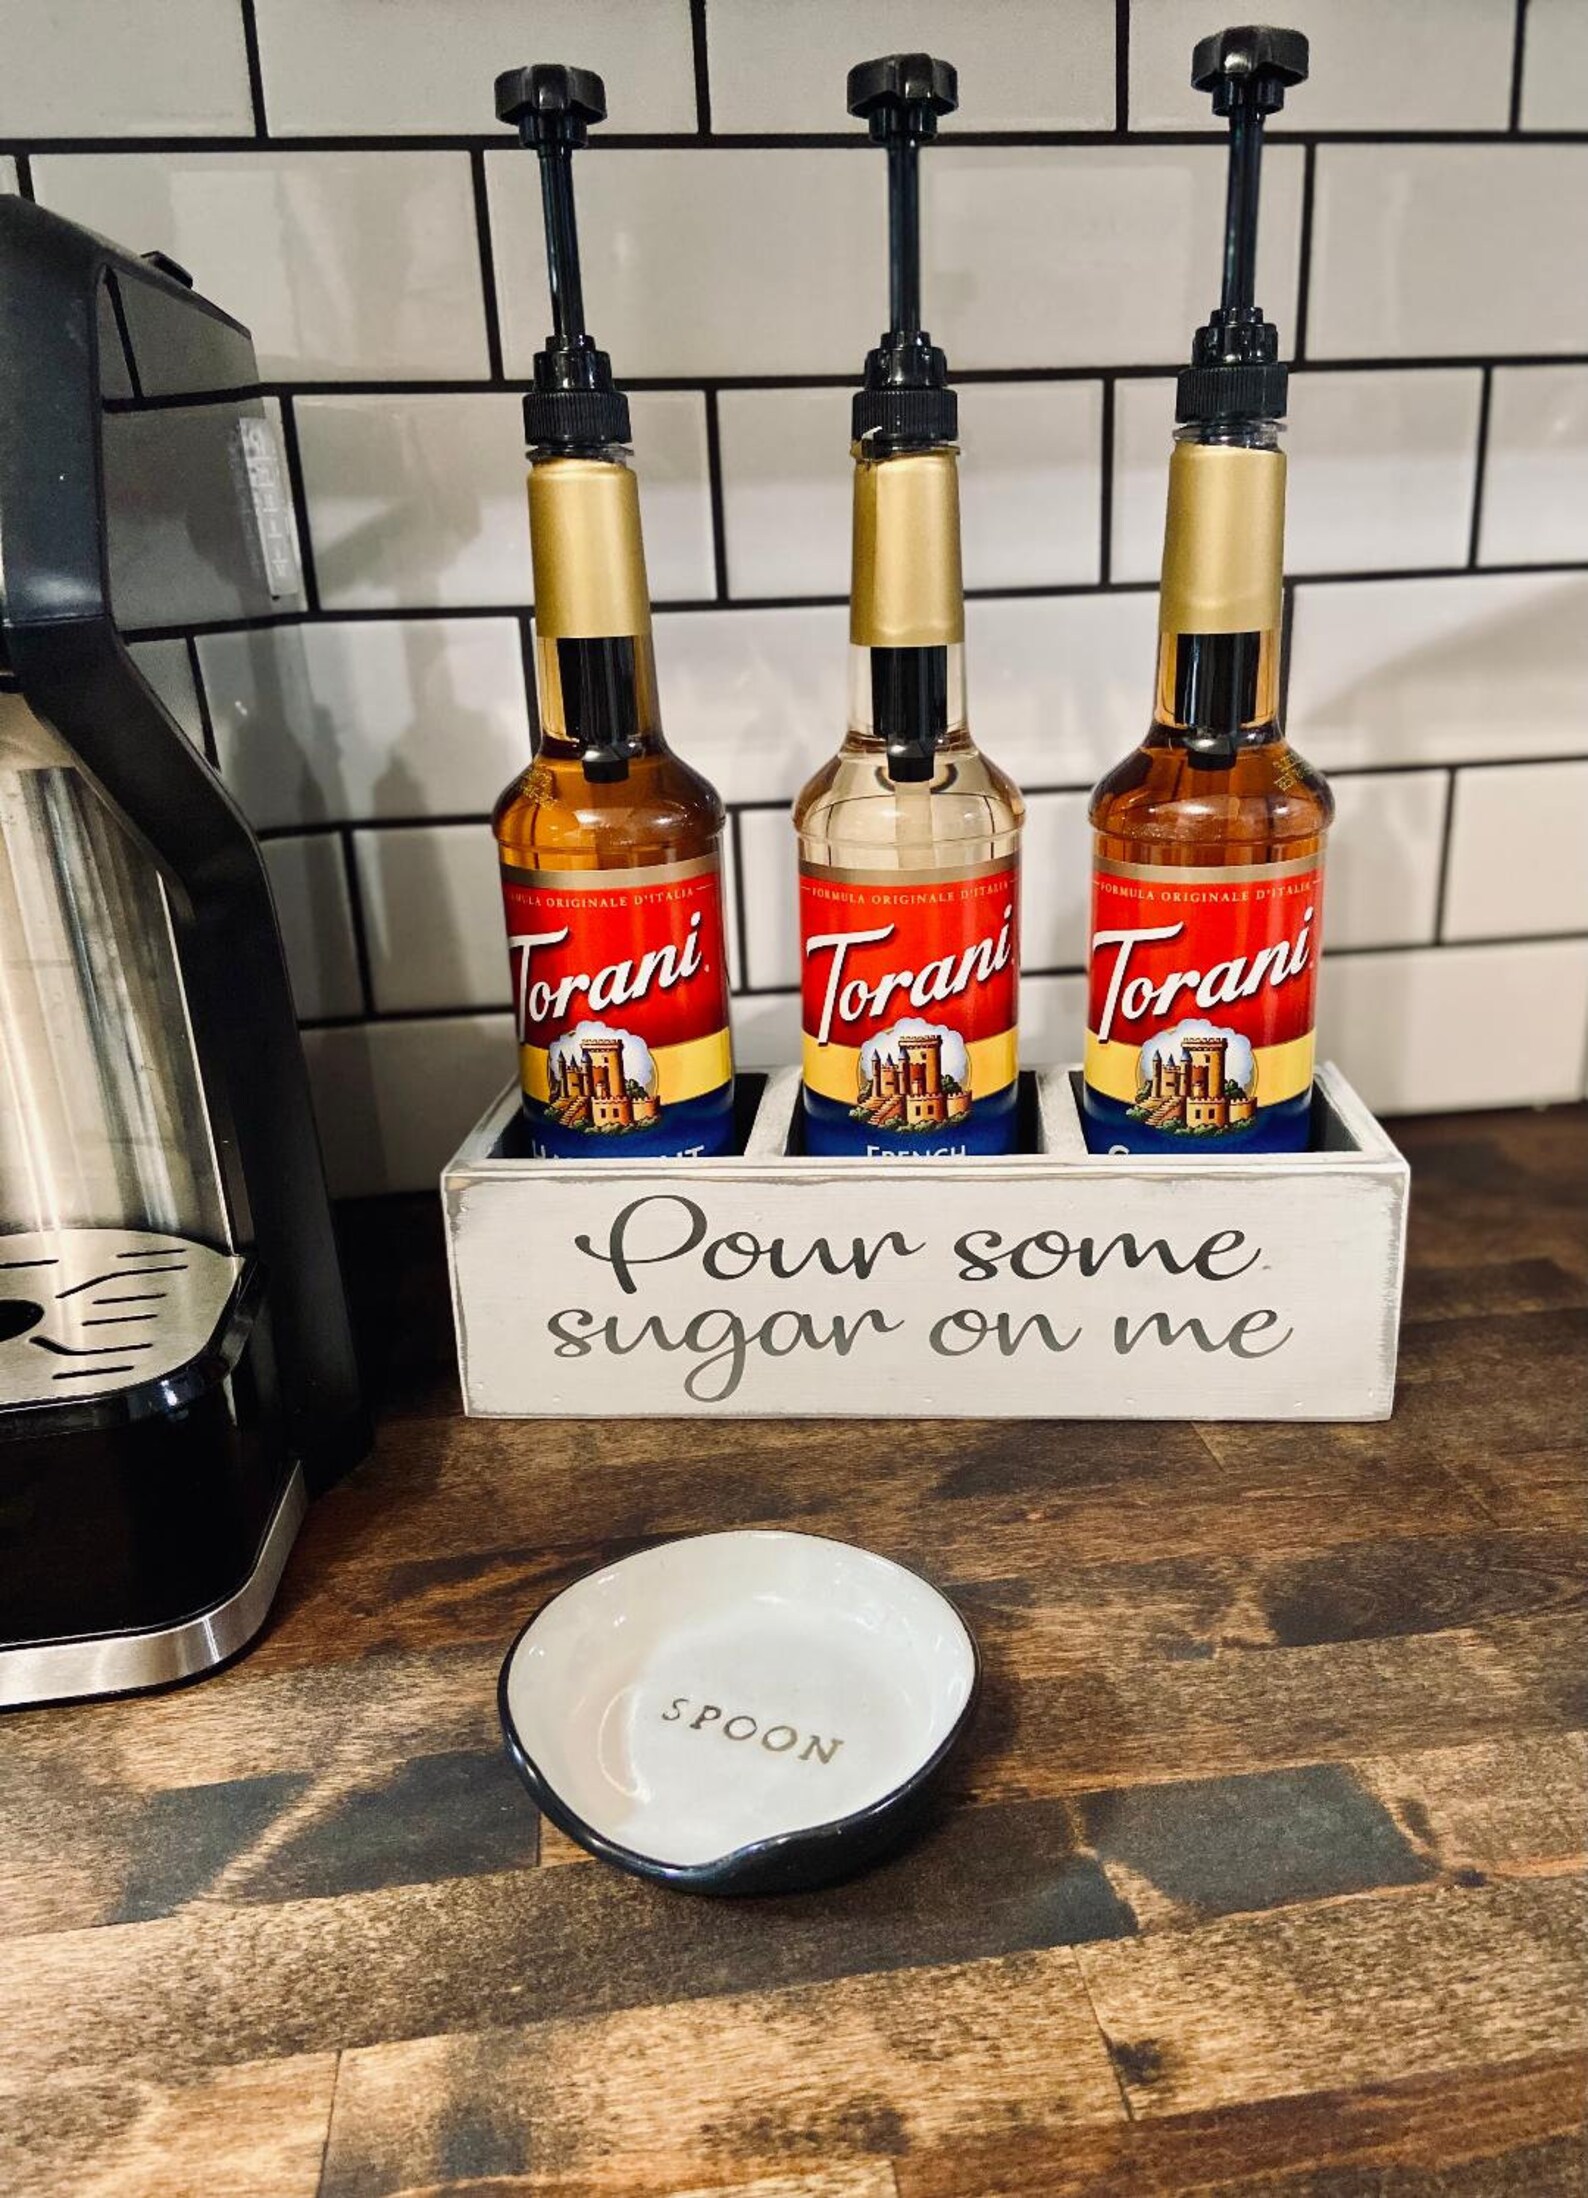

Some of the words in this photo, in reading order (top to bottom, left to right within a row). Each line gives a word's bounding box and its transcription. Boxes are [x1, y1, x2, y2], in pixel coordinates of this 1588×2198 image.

[546, 896, 628, 909] ORIGINALE
[634, 887, 694, 906] D'ITALIA
[871, 891, 954, 905] ORIGINALE
[1100, 881, 1155, 901] FORMULA
[1160, 890, 1249, 903] ORIGINALE
[509, 911, 702, 1044] Torani
[806, 903, 1013, 1047] Torani
[1092, 905, 1315, 1044] Torani
[574, 1194, 927, 1295] Pour
[953, 1229, 1262, 1282] some
[546, 1308, 905, 1403] sugar
[928, 1308, 1083, 1358] on
[1114, 1309, 1295, 1359] me
[661, 1697, 845, 1765] SPOON
